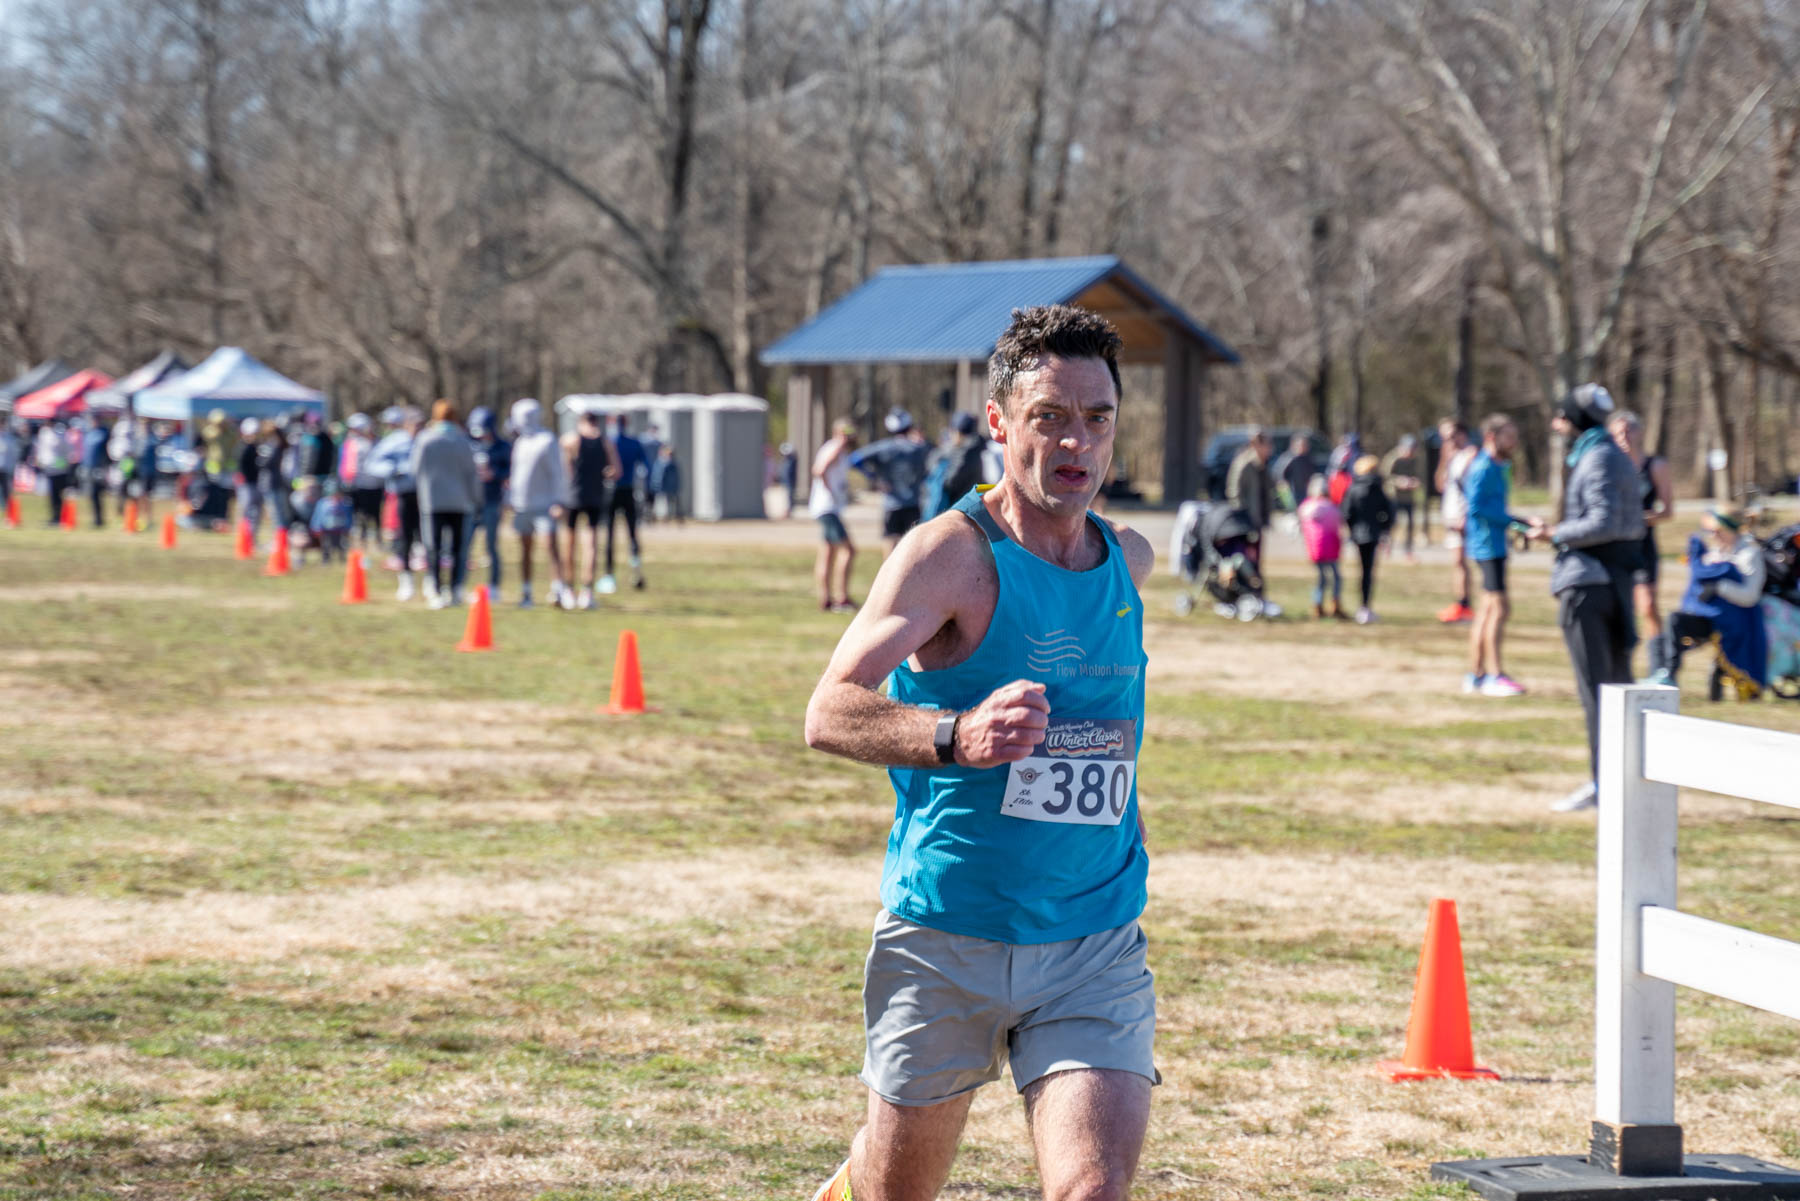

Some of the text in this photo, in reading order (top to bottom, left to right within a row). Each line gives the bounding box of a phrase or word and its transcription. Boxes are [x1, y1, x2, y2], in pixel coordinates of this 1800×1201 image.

[1056, 663, 1076, 677] Flow
[1079, 662, 1112, 676] Motion
[1047, 728, 1121, 749] Winter Classic
[1041, 762, 1128, 818] 380
